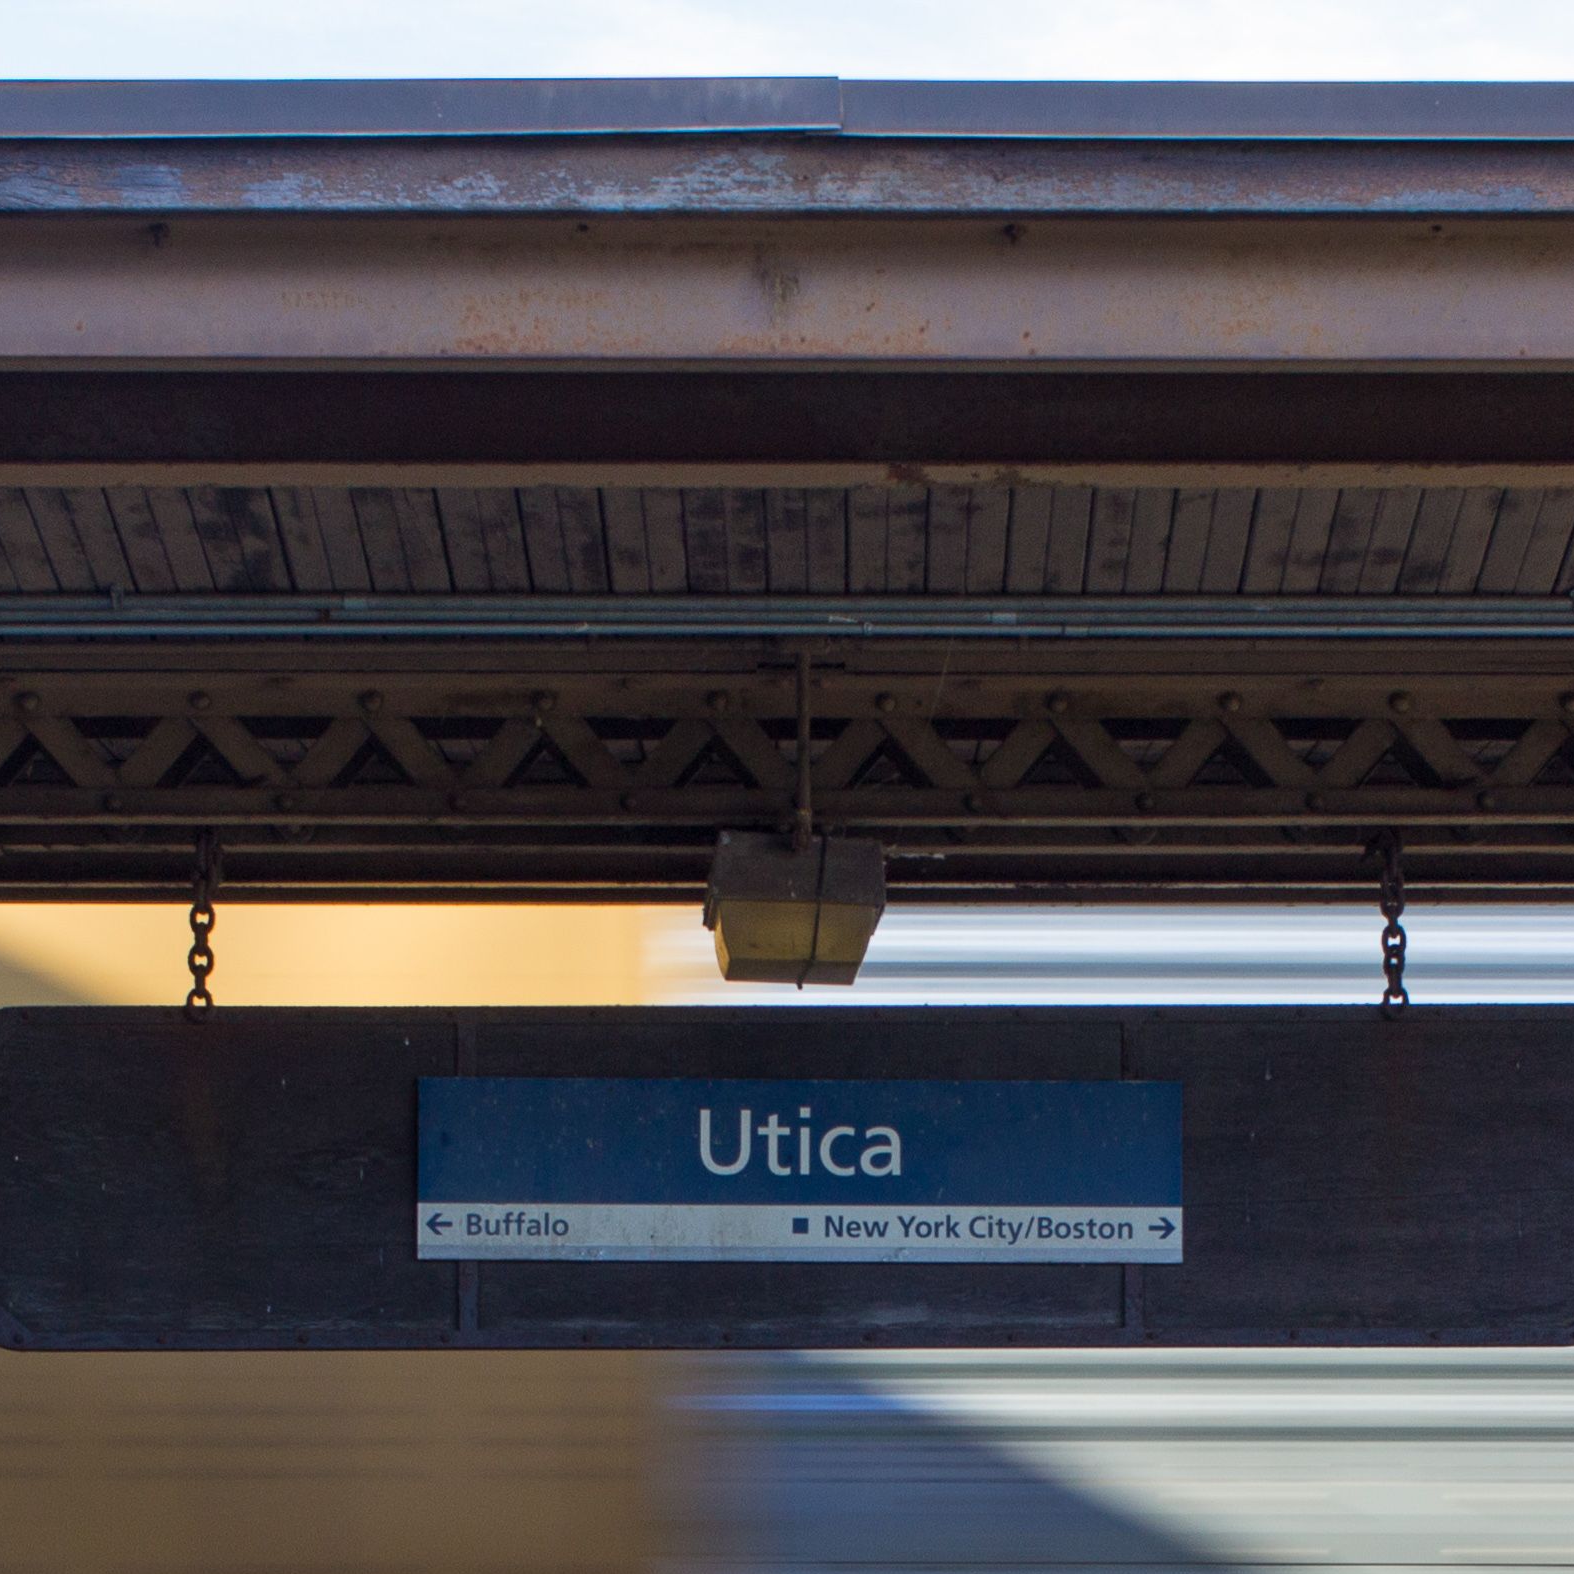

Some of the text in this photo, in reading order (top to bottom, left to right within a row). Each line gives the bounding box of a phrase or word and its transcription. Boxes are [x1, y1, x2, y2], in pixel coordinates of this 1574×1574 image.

[697, 1107, 902, 1177] Utica
[465, 1212, 570, 1238] Buffalo
[824, 1215, 1134, 1244] New York City/Boston
